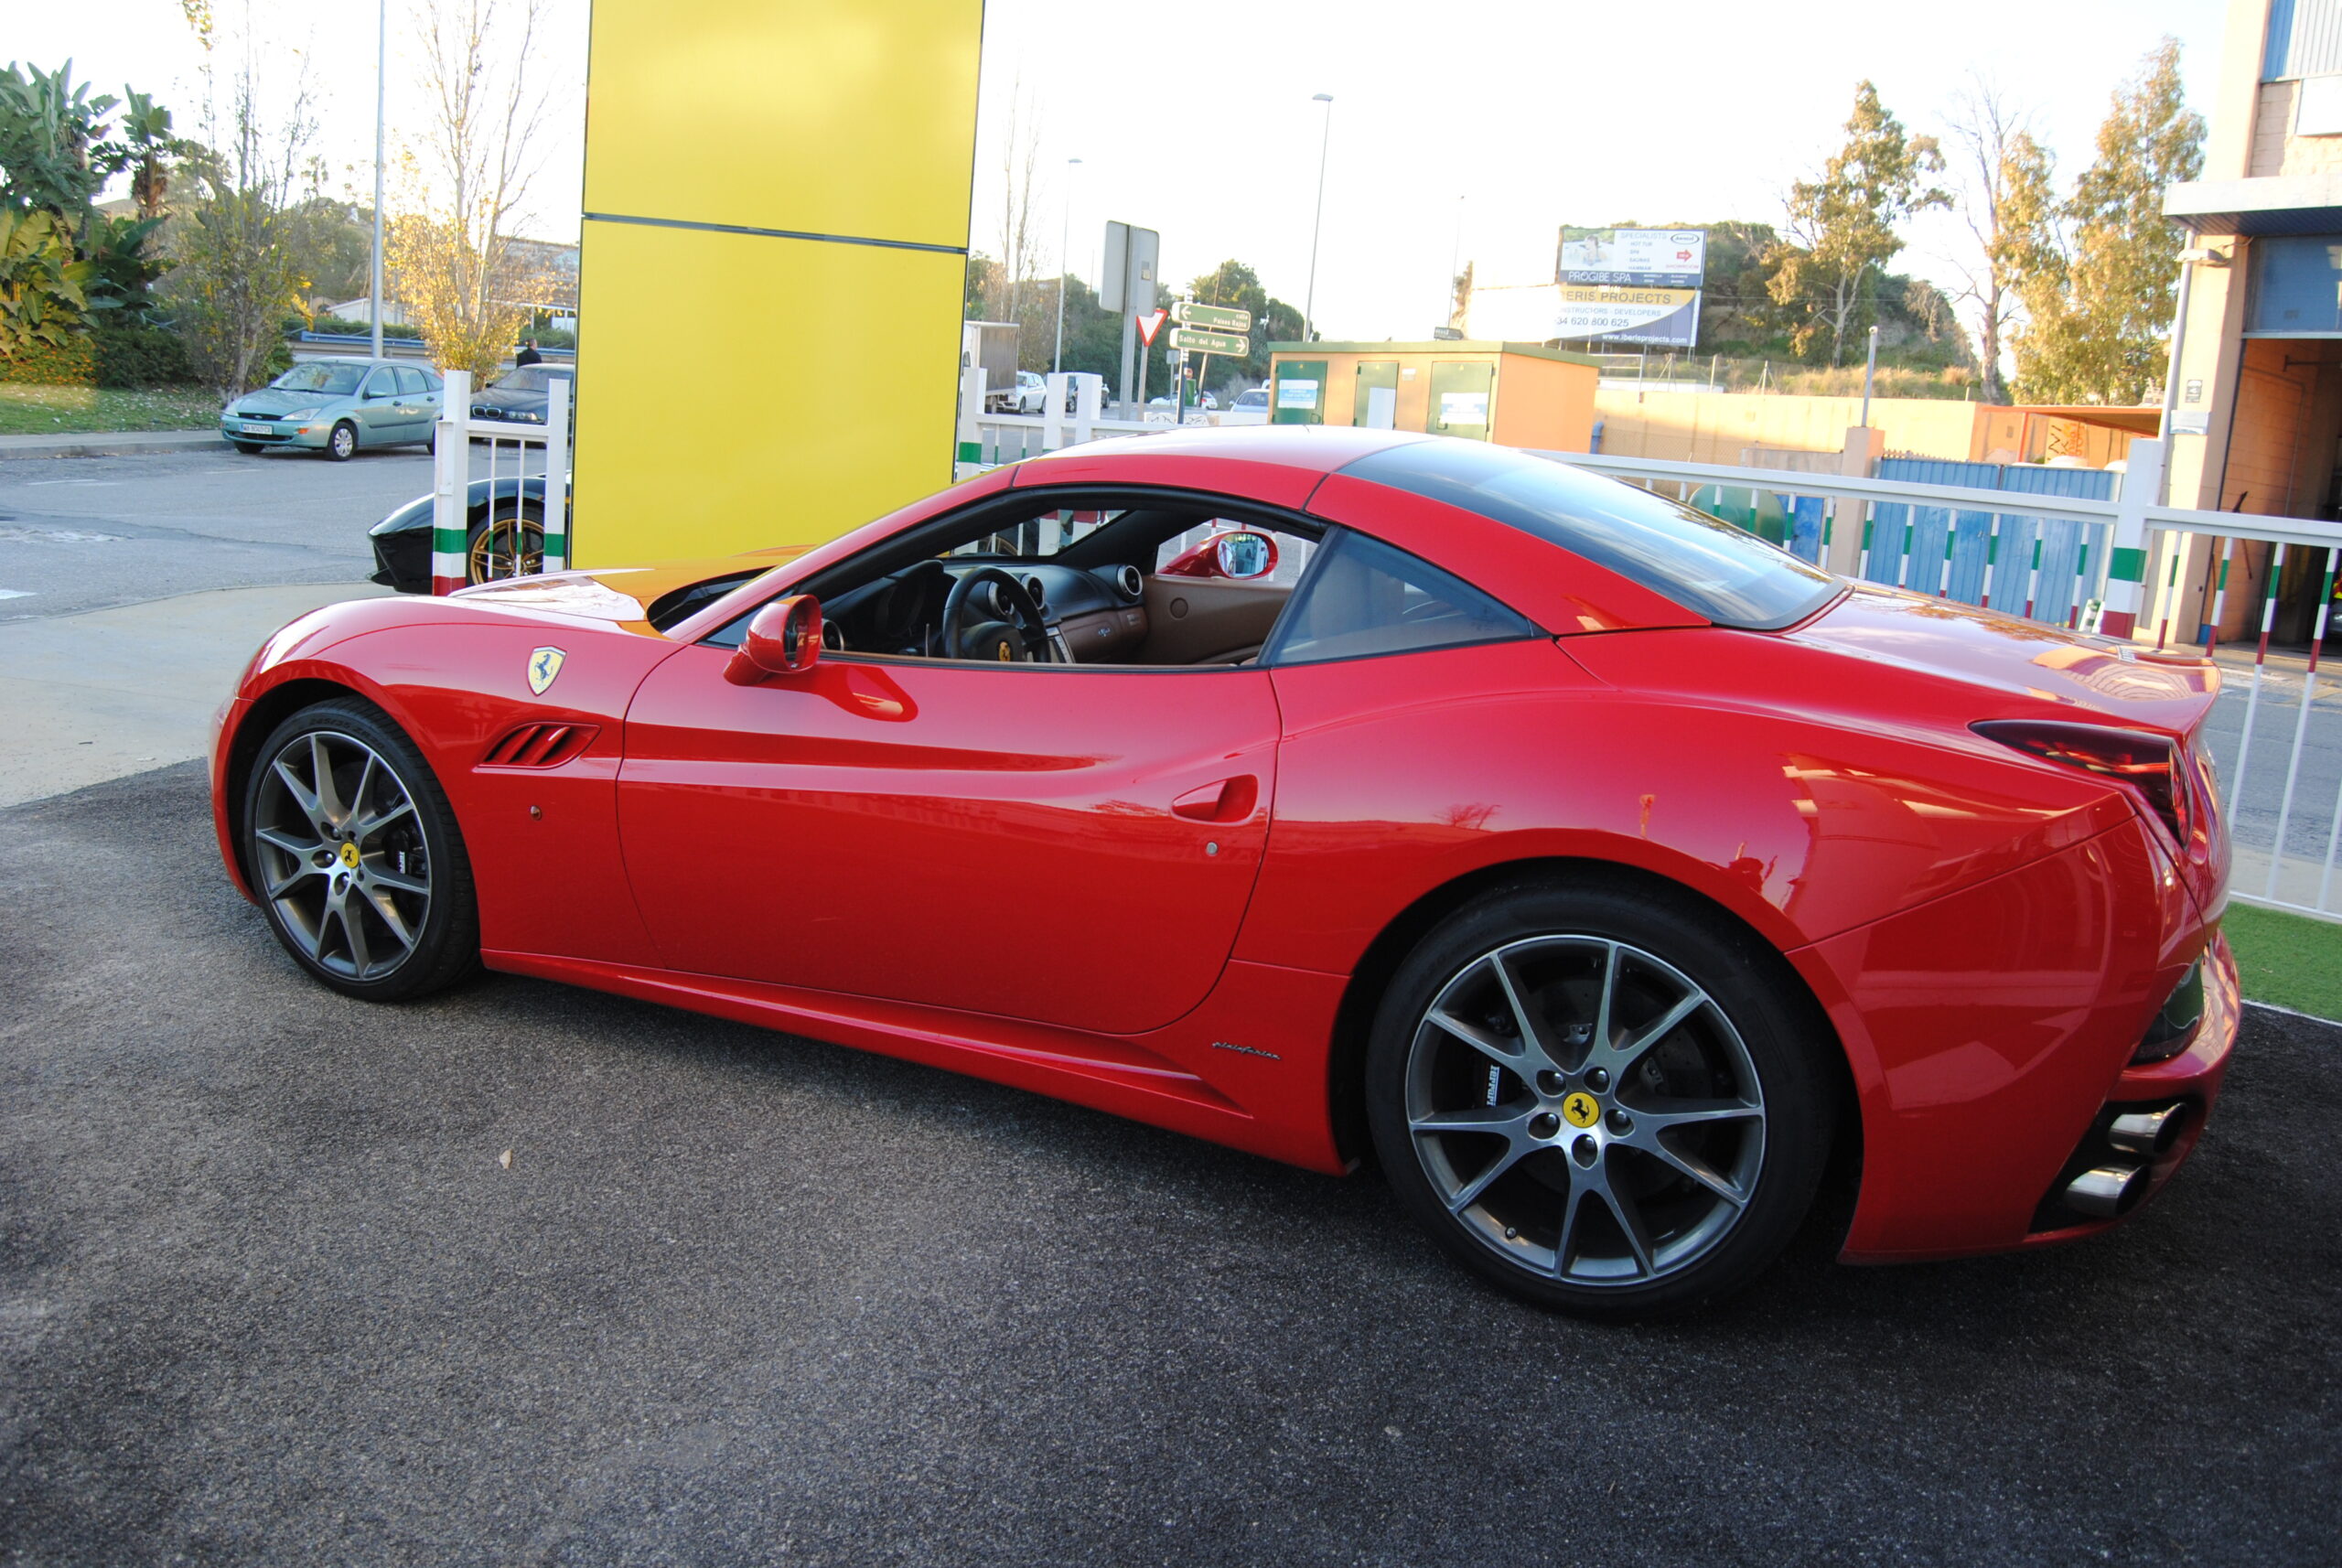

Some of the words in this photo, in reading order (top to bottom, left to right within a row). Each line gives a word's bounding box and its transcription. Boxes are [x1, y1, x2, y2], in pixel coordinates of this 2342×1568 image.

[1568, 271, 1610, 282] PROGIBE
[1613, 273, 1632, 283] SPA
[1562, 291, 1596, 301] ERIS
[1601, 292, 1671, 304] PROJECTS
[1615, 308, 1661, 317] DEVELOPERS
[1571, 317, 1588, 325] 620
[1592, 317, 1608, 326] 800
[1611, 318, 1629, 327] 625
[1178, 335, 1196, 344] Salto
[1211, 339, 1226, 348] Agua
[1487, 1065, 1500, 1106] Ferrari
